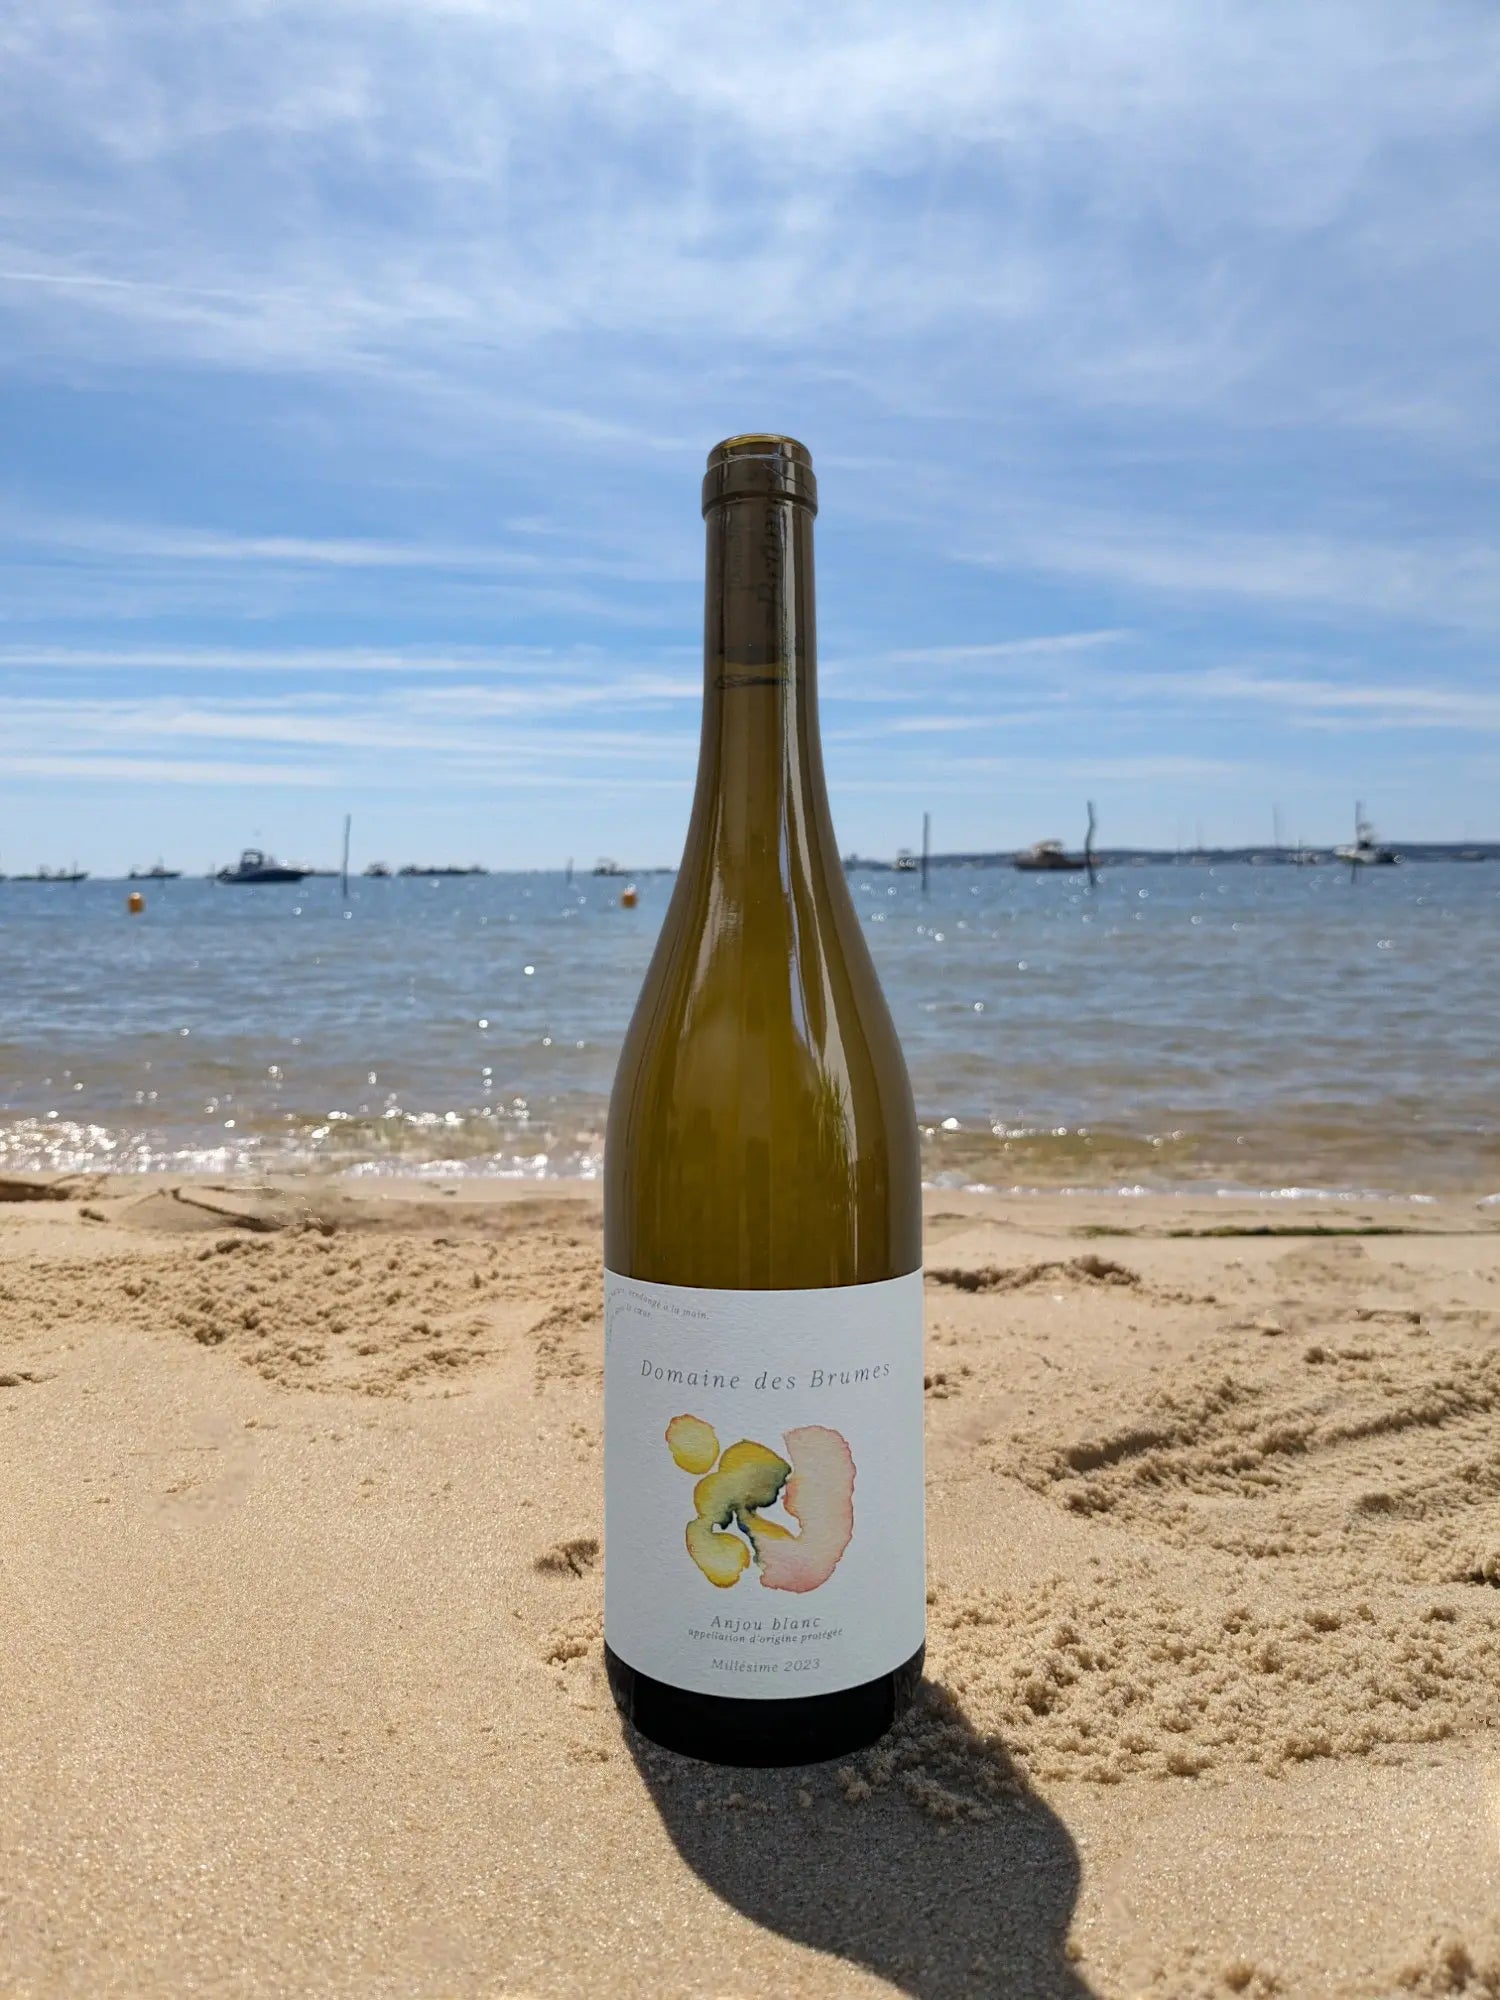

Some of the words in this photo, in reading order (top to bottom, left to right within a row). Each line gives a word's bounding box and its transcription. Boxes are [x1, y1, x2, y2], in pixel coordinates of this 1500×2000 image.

[640, 1358, 741, 1390] Domaine
[754, 1370, 796, 1390] des
[808, 1362, 891, 1389] Brumes
[710, 1615, 762, 1633] Anjou
[772, 1617, 821, 1631] blanc
[688, 1627, 745, 1643] appellation
[749, 1633, 798, 1646] d'origine
[711, 1657, 778, 1673] Millésime
[783, 1658, 821, 1672] 2023
